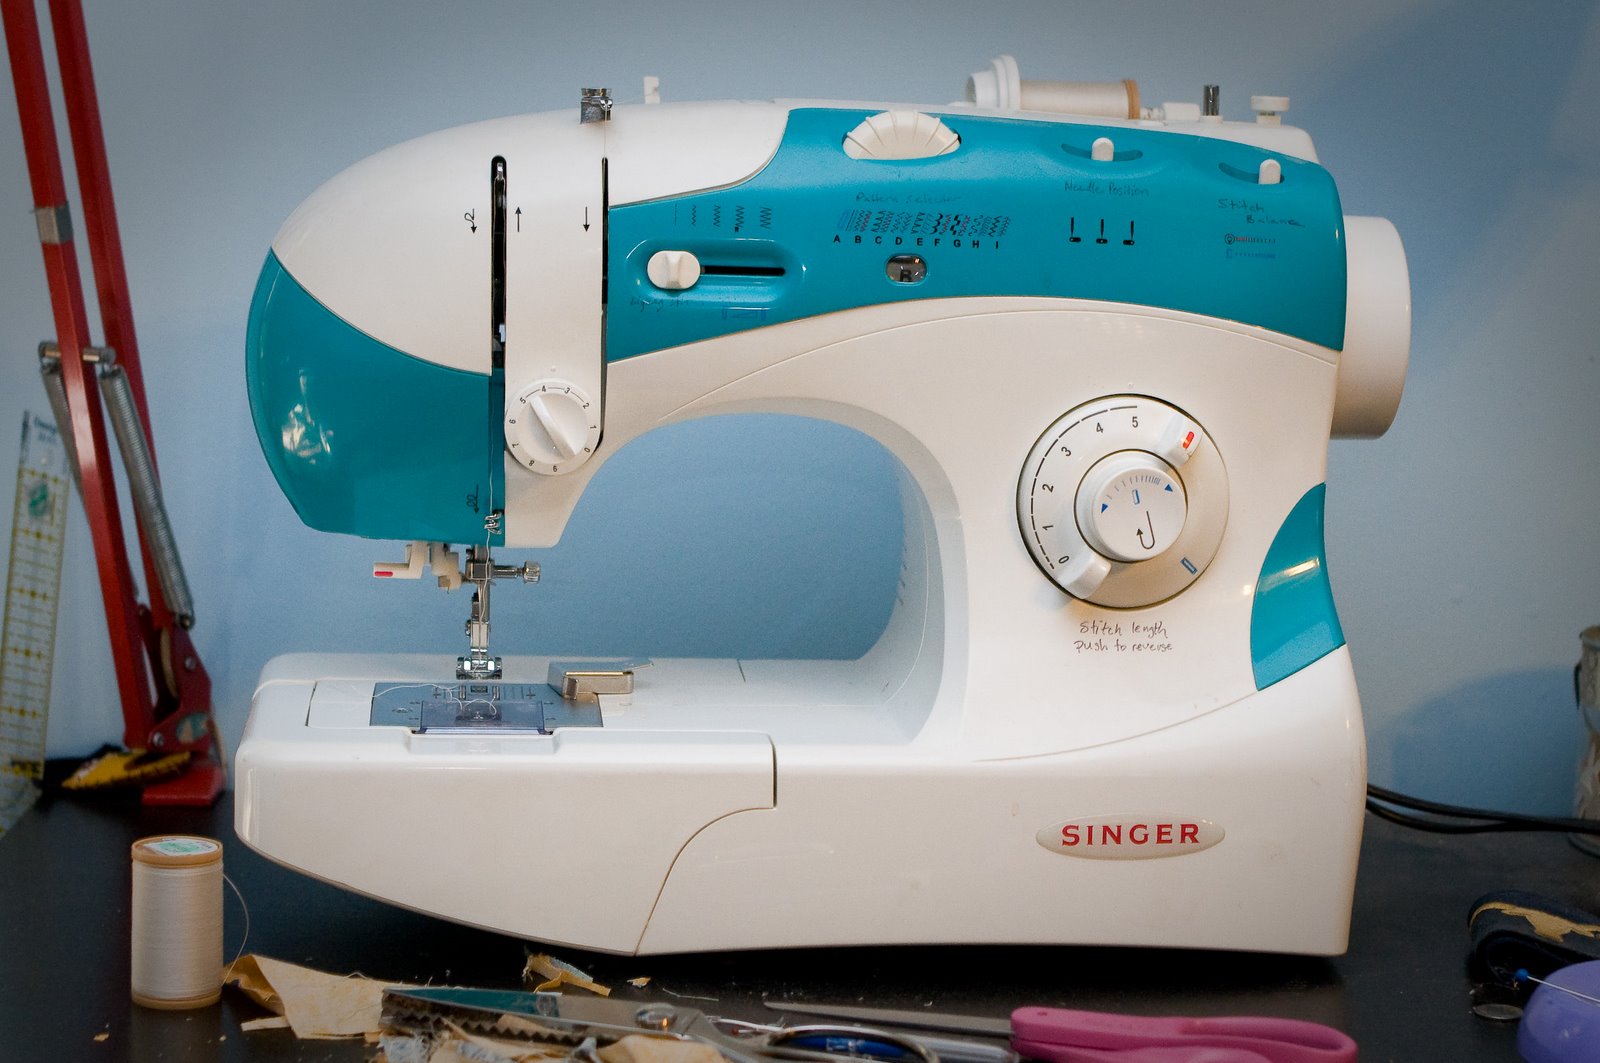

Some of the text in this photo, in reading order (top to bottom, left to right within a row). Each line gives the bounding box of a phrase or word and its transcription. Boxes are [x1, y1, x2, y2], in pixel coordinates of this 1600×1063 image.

[1109, 181, 1150, 197] Position
[1218, 198, 1265, 213] Stitch
[833, 234, 841, 243] A
[854, 235, 862, 244] B
[875, 236, 882, 244] C
[895, 237, 903, 245] D
[917, 237, 924, 246] E
[934, 238, 941, 247] F
[953, 239, 961, 248] G
[972, 240, 980, 248] H
[1095, 422, 1104, 434] 4
[1131, 416, 1139, 428] 5
[1061, 446, 1072, 457] 3
[1042, 483, 1054, 493] 2
[1058, 555, 1070, 564] 0
[1080, 620, 1168, 638] Stitch length
[1114, 639, 1127, 652] to
[1132, 643, 1173, 652] reverse
[1061, 823, 1201, 846] SINGER
